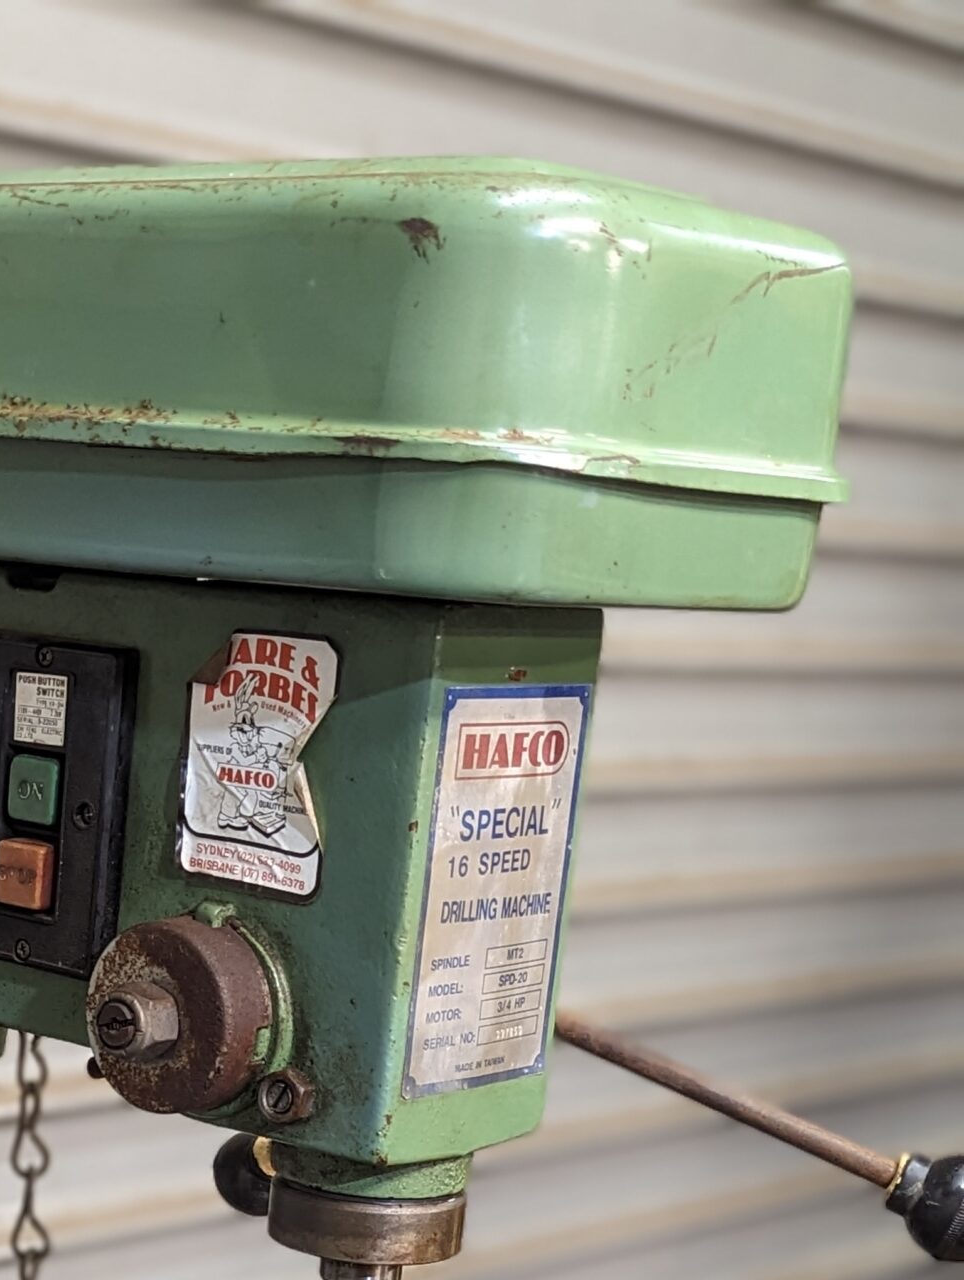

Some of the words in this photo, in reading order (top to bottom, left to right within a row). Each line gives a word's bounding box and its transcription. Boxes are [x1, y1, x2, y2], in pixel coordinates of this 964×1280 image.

[227, 638, 296, 673] ARE
[301, 656, 320, 691] &
[18, 675, 36, 684] PUSH
[37, 677, 65, 687] BUTTON
[36, 686, 65, 698] SWITCH
[260, 701, 276, 711] Used
[226, 747, 233, 755] OF
[462, 730, 565, 770] HAFCO
[219, 766, 275, 789] HAFCO
[18, 782, 44, 800] ON
[259, 800, 281, 811] QUALITY
[197, 842, 237, 859] SYDNEY
[189, 857, 239, 875] BRISBANE
[448, 855, 469, 878] 16
[478, 848, 531, 876] SPEED
[441, 899, 497, 924] DRILLING
[500, 892, 552, 919] MACHINE
[430, 955, 471, 971] SPINDLE
[507, 947, 525, 960] MT2
[428, 982, 464, 997] MODEL:
[498, 971, 528, 987] SPD-20
[497, 1000, 512, 1013] 3/4
[514, 997, 526, 1009] HP
[422, 1036, 456, 1051] SERIAL
[459, 1031, 476, 1045] NO:
[454, 1062, 473, 1073] MADE
[475, 1060, 483, 1069] IN
[484, 1055, 506, 1068] TAIWAN
